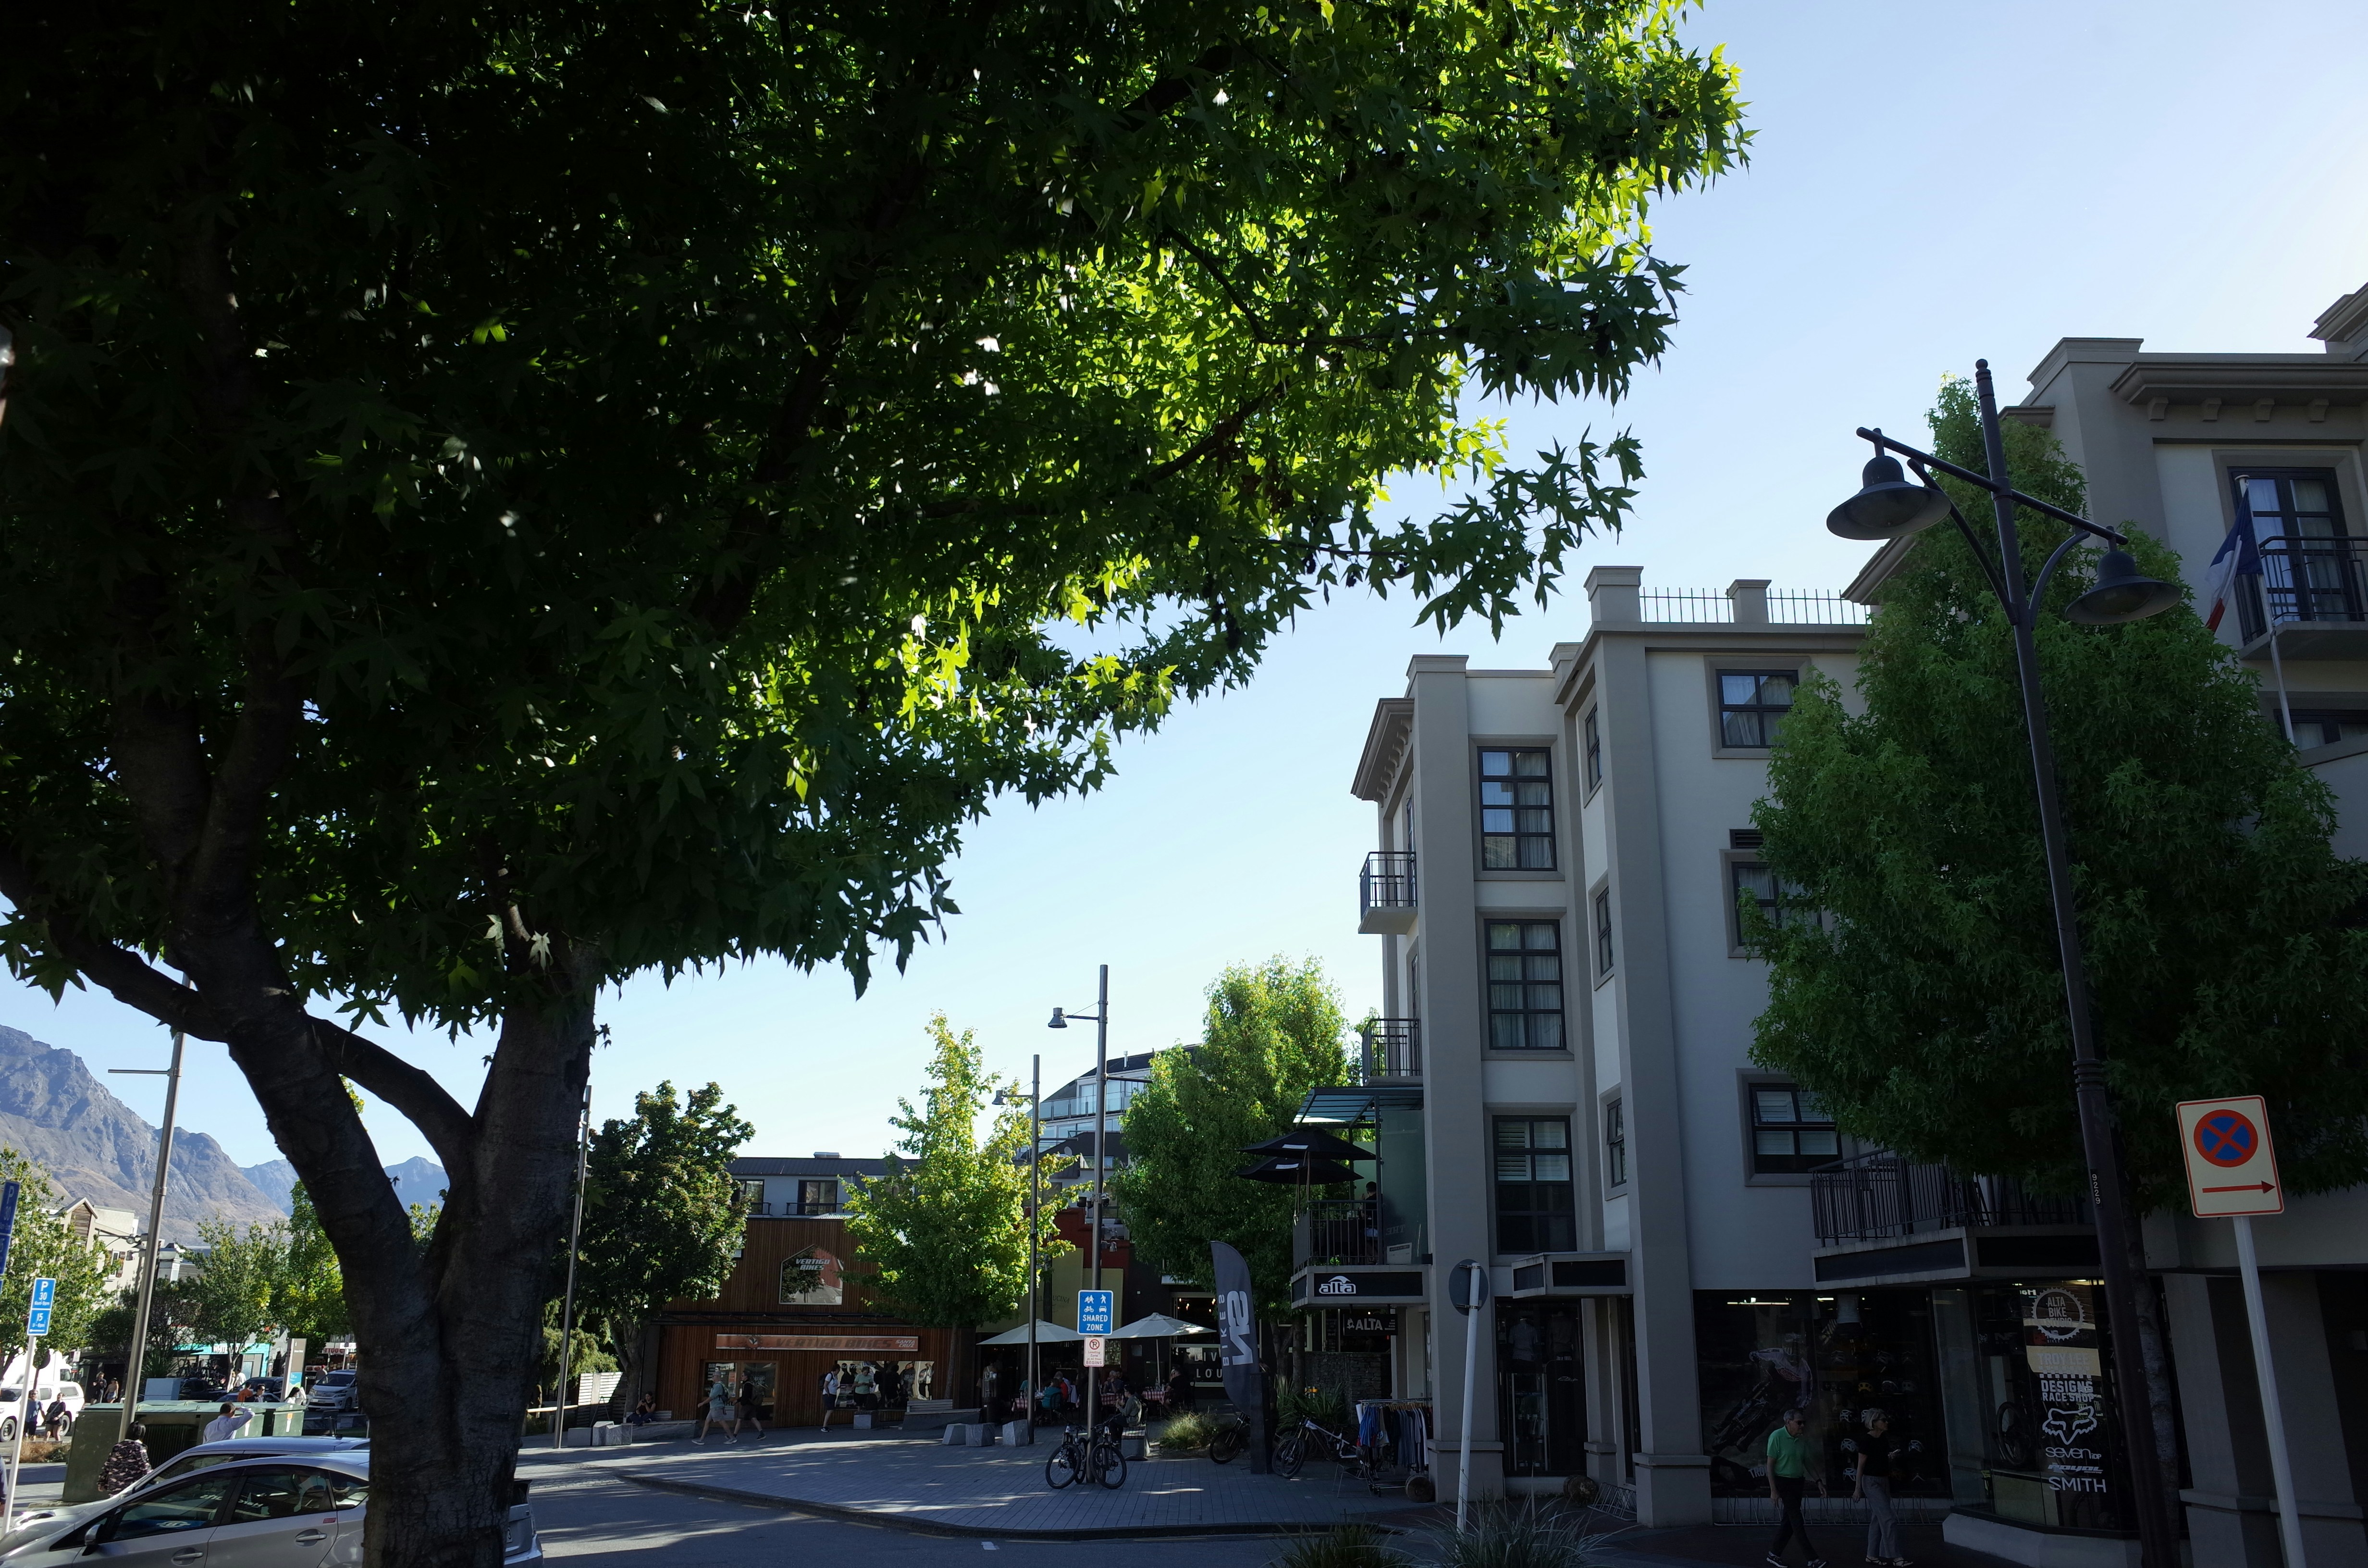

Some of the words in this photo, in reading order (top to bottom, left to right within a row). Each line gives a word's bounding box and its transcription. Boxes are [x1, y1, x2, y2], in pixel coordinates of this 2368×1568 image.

[2092, 1174, 2101, 1204] 9229
[41, 1281, 48, 1292] P
[1319, 1282, 1357, 1294] alta
[39, 1292, 47, 1300] 30
[2047, 1297, 2066, 1307] ALTA
[2048, 1307, 2067, 1317] BIKE
[1355, 1318, 1383, 1331] ALTA
[776, 1338, 842, 1347] VERTIGO
[844, 1339, 892, 1348] BIKES
[1195, 1352, 1218, 1362] LIV
[2038, 1352, 2066, 1365] TROY
[2070, 1353, 2089, 1365] LEE
[1196, 1368, 1222, 1378] LOU
[2041, 1380, 2094, 1393] DESIGNS
[2042, 1392, 2069, 1402] RACE
[2069, 1393, 2095, 1403] SHOP
[2045, 1447, 2092, 1459] seven
[2048, 1476, 2107, 1493] SMITH
